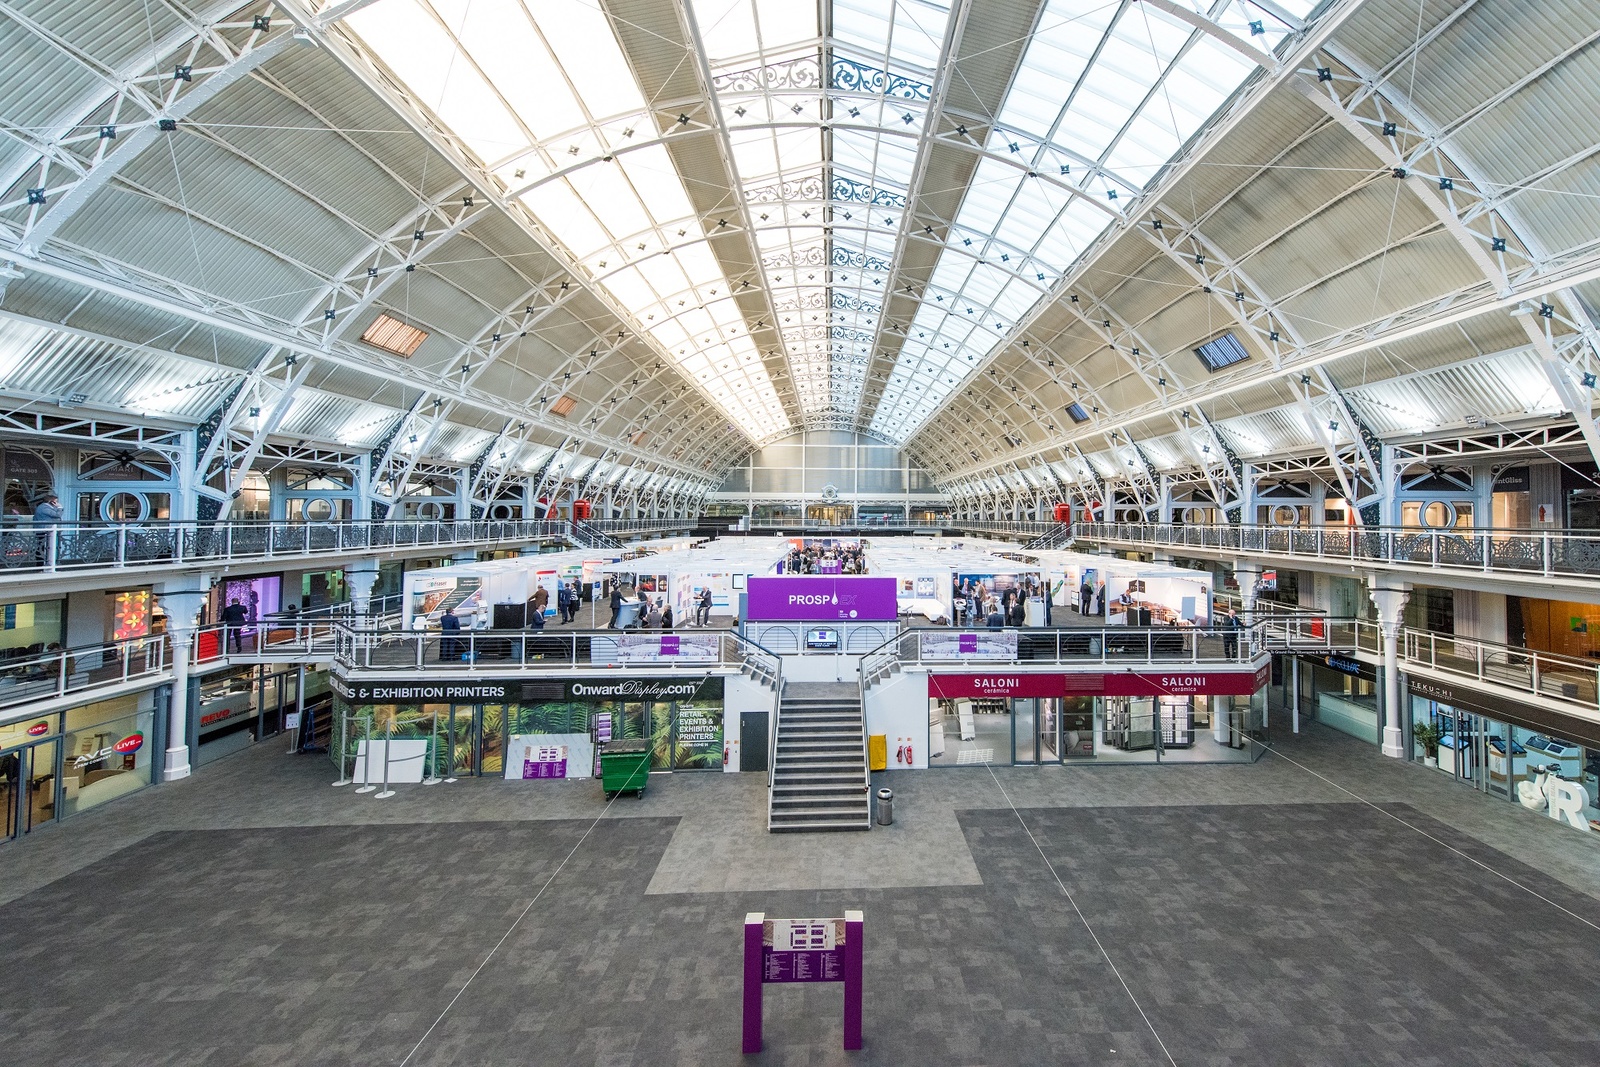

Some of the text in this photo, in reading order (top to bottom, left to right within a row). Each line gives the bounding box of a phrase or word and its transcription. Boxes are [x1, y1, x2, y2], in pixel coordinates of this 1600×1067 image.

[974, 678, 1019, 688] SALONI
[1162, 677, 1206, 686] SALONI
[359, 688, 370, 698] &
[373, 687, 443, 698] EXHIBITION
[446, 686, 505, 697] PRINTERS
[201, 708, 230, 723] REVO
[74, 739, 136, 765] AVC LIVE
